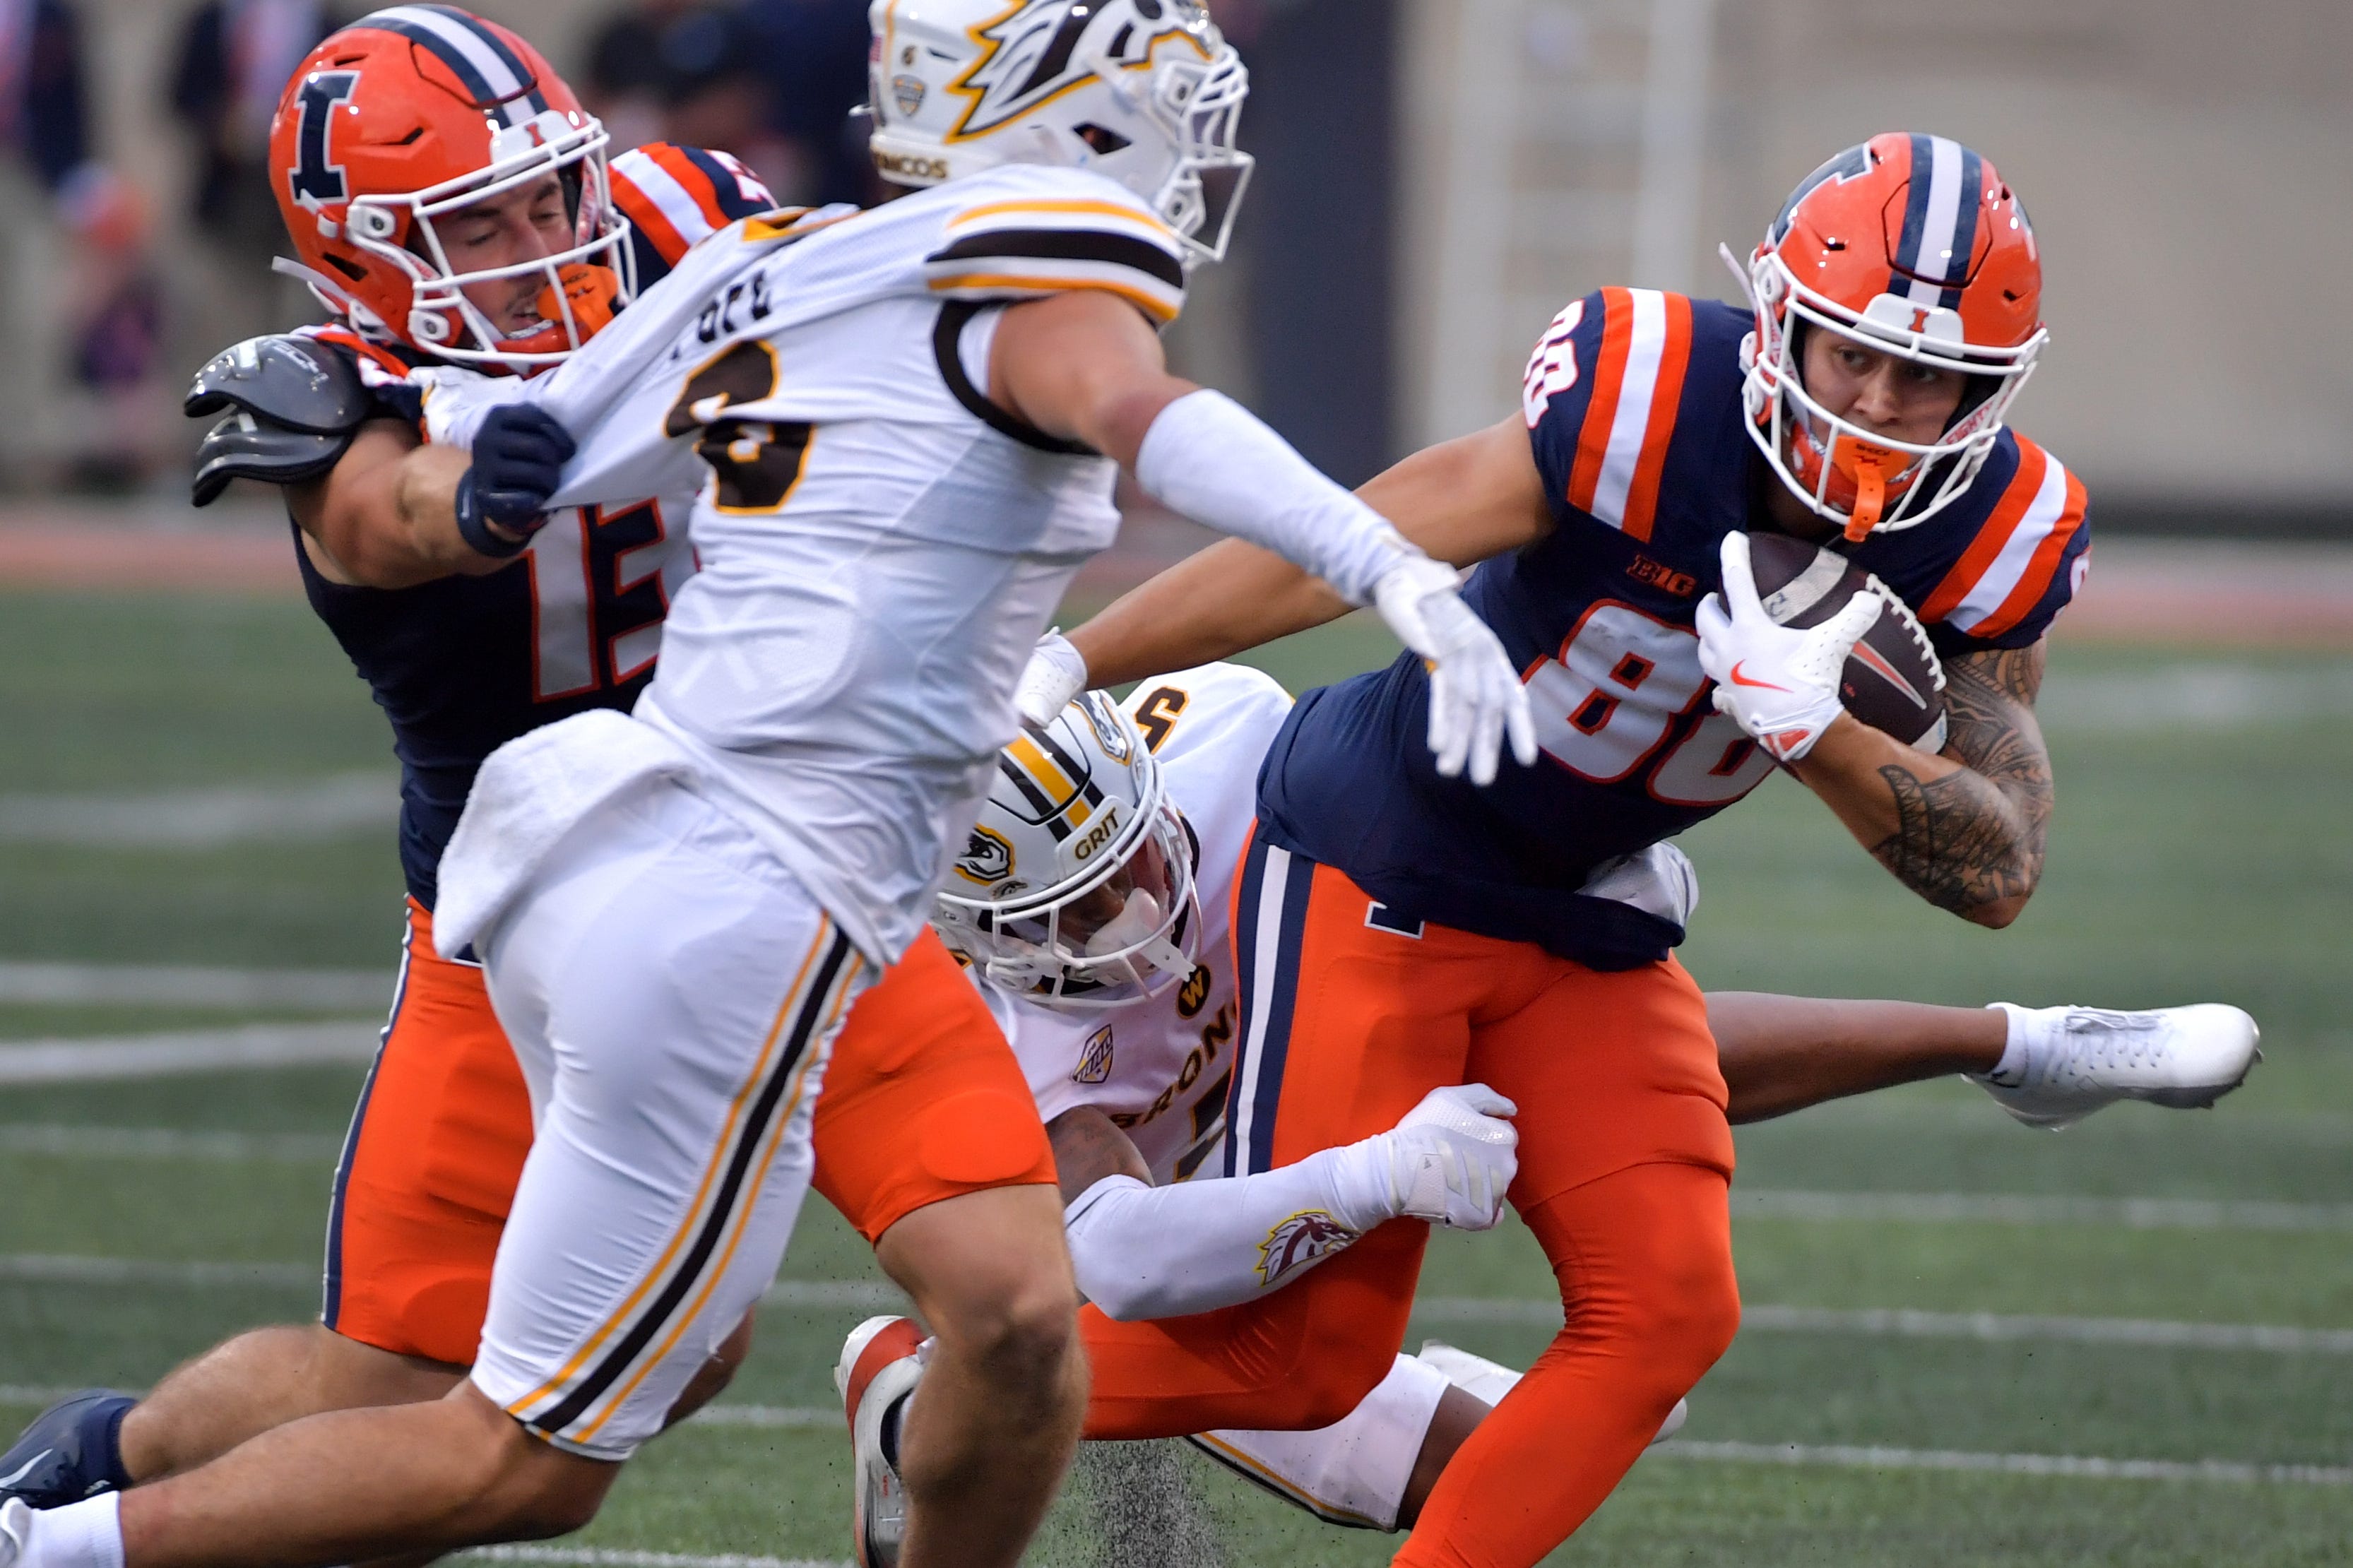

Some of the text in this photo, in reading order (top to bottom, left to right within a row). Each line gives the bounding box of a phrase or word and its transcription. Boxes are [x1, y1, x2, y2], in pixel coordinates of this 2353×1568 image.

[288, 69, 362, 206] I
[523, 121, 547, 148] I
[1908, 307, 1930, 333] I
[1074, 807, 1118, 860] GRIT
